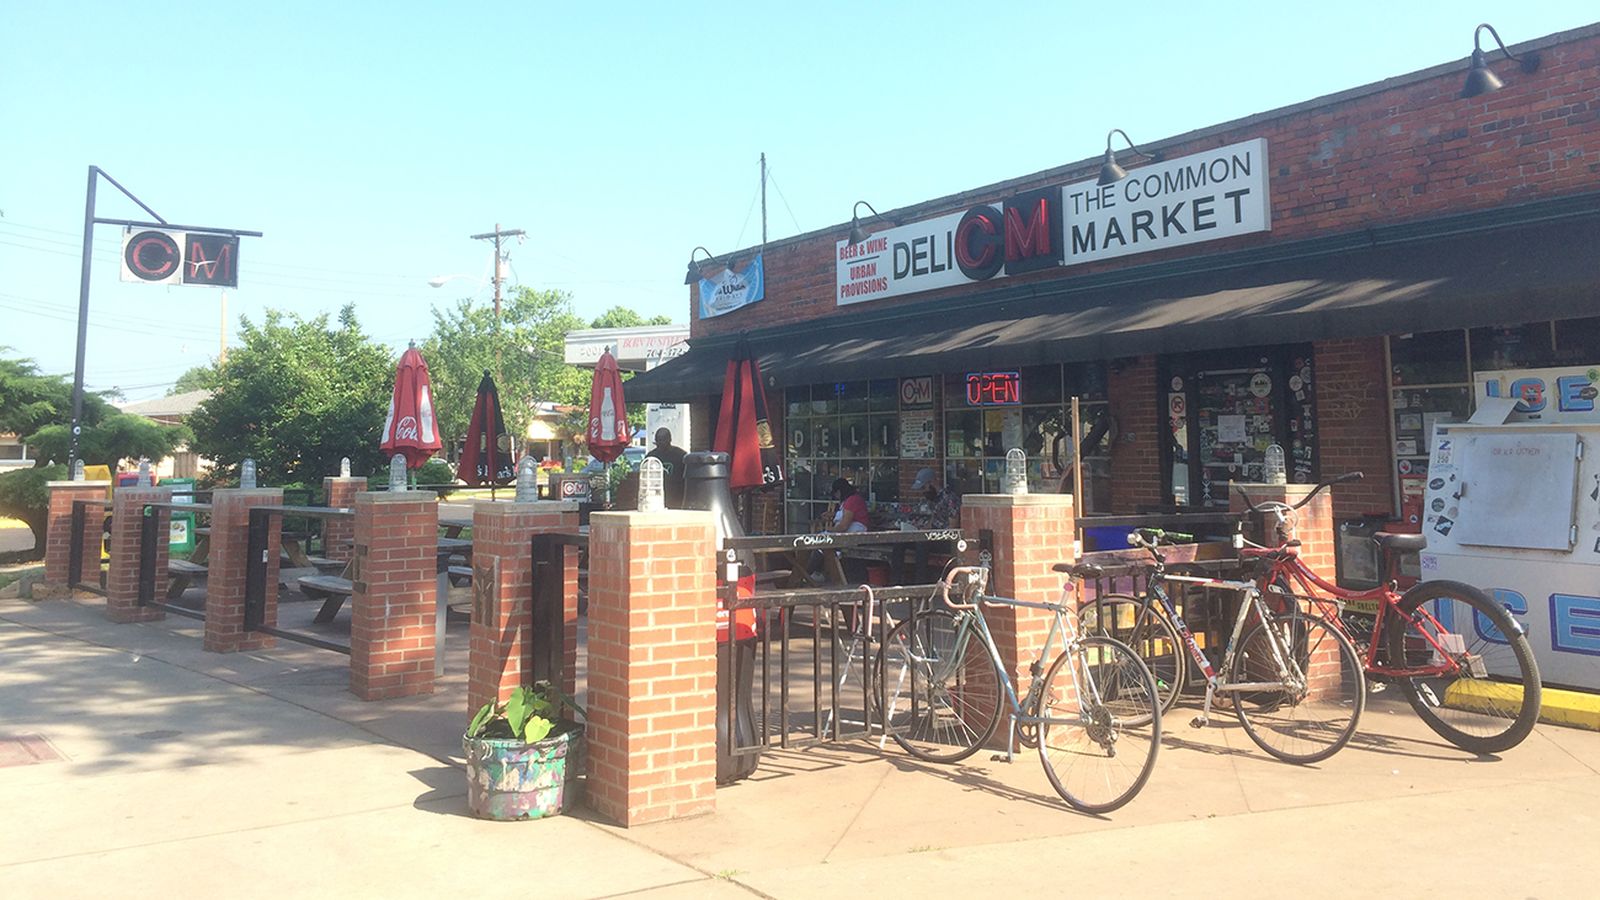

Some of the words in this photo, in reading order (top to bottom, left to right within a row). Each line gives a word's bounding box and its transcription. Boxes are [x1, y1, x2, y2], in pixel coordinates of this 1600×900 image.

[1070, 184, 1116, 215] THE
[1124, 152, 1251, 202] COMMON
[1071, 188, 1251, 255] MARKET
[839, 243, 858, 261] BEER
[859, 245, 865, 257] &
[866, 237, 888, 255] WINE
[893, 231, 953, 280] DELI
[840, 277, 888, 299] PROVISIONS
[850, 263, 877, 281] URBAN
[967, 373, 1020, 405] OPEN
